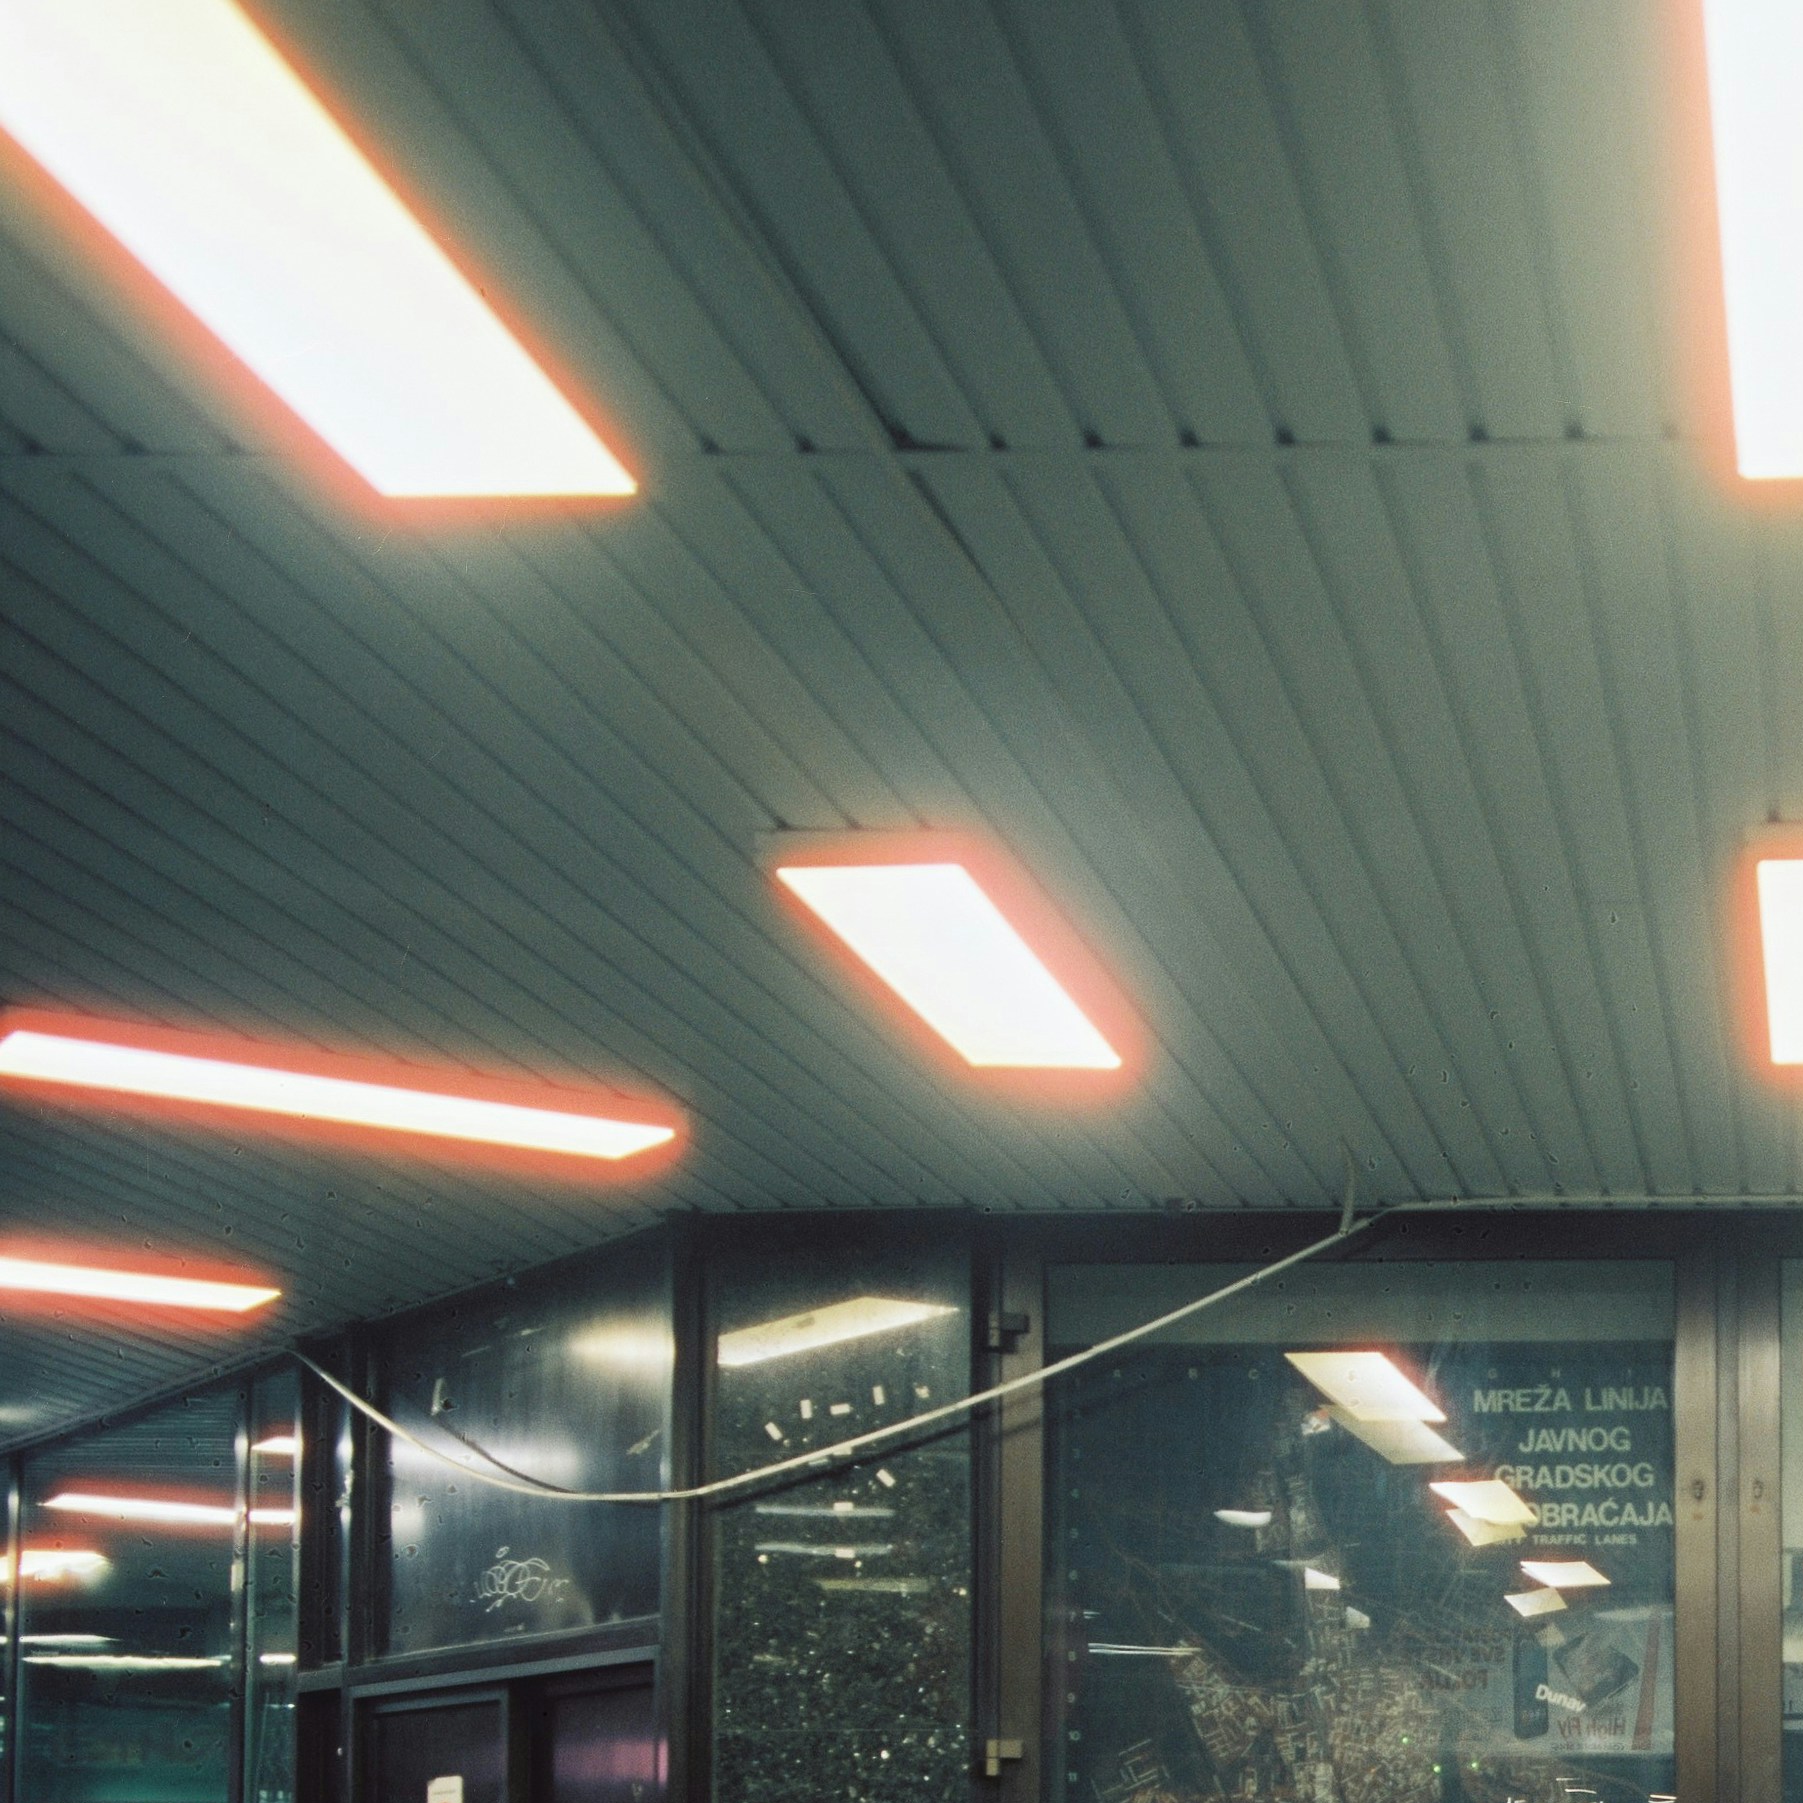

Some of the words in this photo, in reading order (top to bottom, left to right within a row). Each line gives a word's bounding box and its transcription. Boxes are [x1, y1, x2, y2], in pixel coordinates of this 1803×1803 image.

[1474, 1384, 1571, 1413] MREŽA
[1585, 1387, 1668, 1412] LINIJA
[1518, 1426, 1631, 1454] JAVNOG
[1495, 1462, 1655, 1490] GRADSKOG
[1524, 1497, 1672, 1529] OBRAĆAJA
[1532, 1533, 1587, 1546] TRAFFIC
[1594, 1533, 1638, 1546] LANES
[1535, 1683, 1588, 1715] Dunav
[1067, 1730, 1081, 1742] 10
